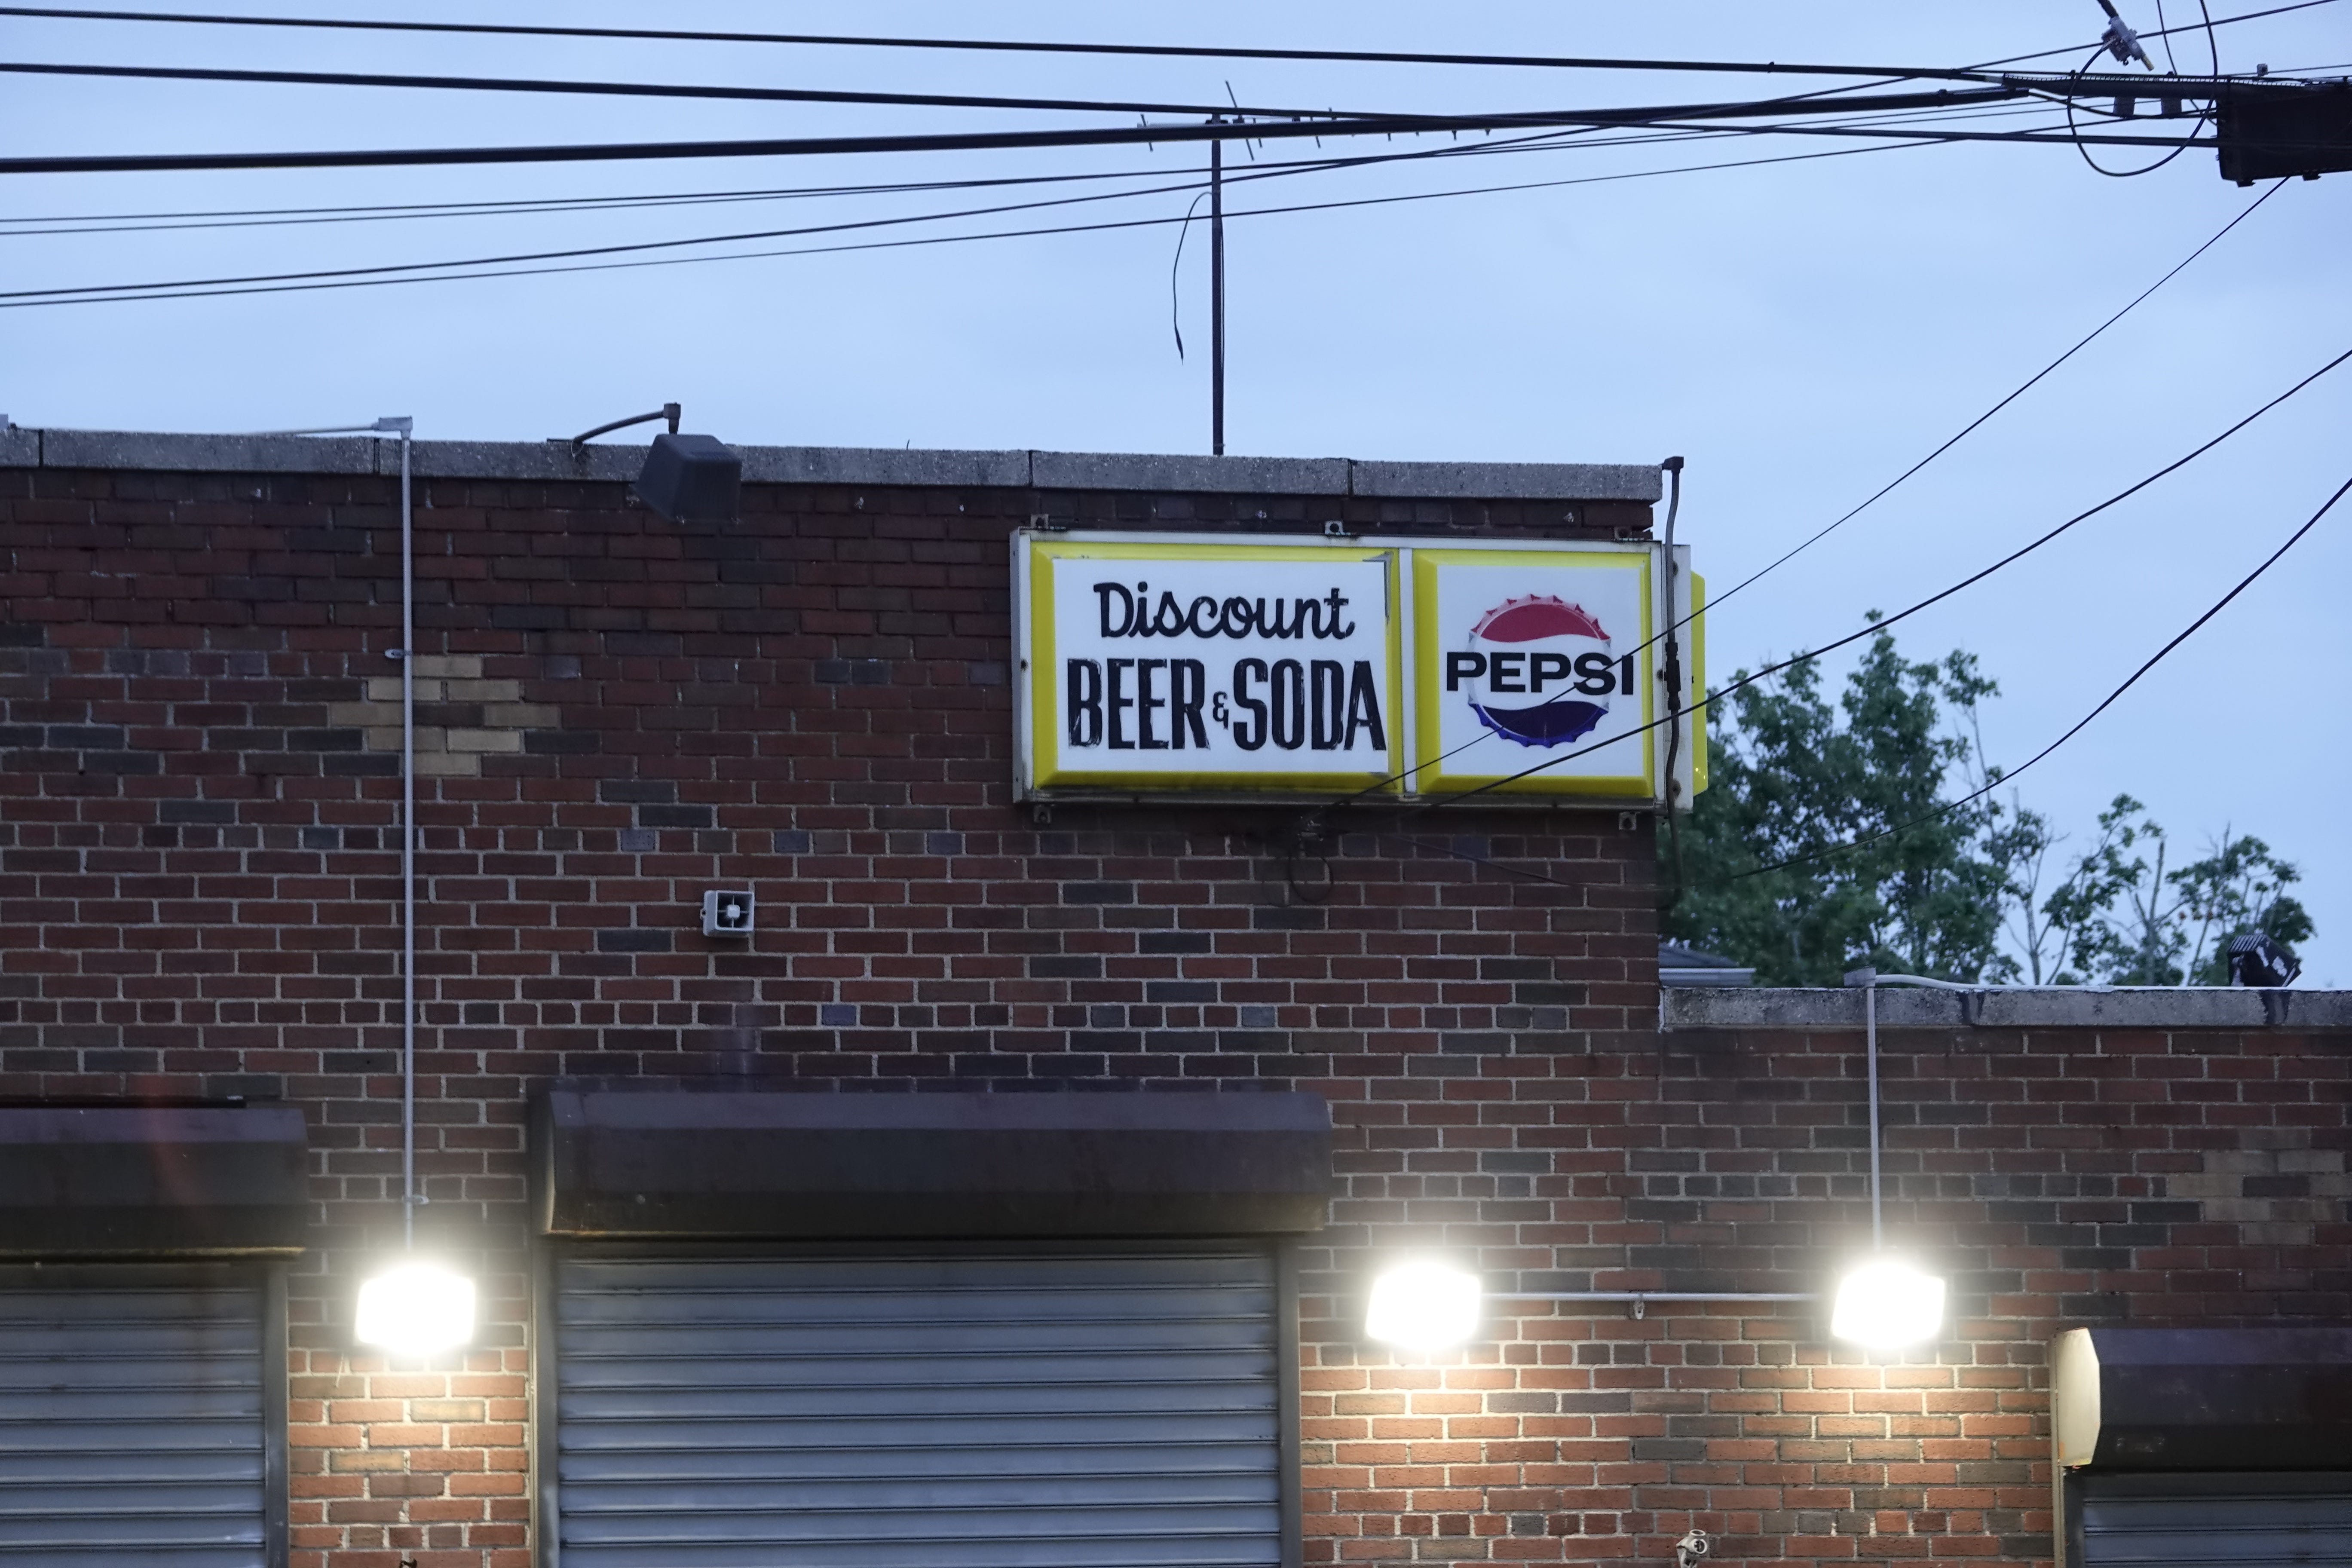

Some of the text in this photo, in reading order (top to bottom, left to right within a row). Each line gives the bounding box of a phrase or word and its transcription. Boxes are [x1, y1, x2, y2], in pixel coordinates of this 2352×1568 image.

[1093, 581, 1355, 640] Discount
[1446, 651, 1634, 695] PEPSI
[1067, 658, 1387, 751] BEER & SODA
